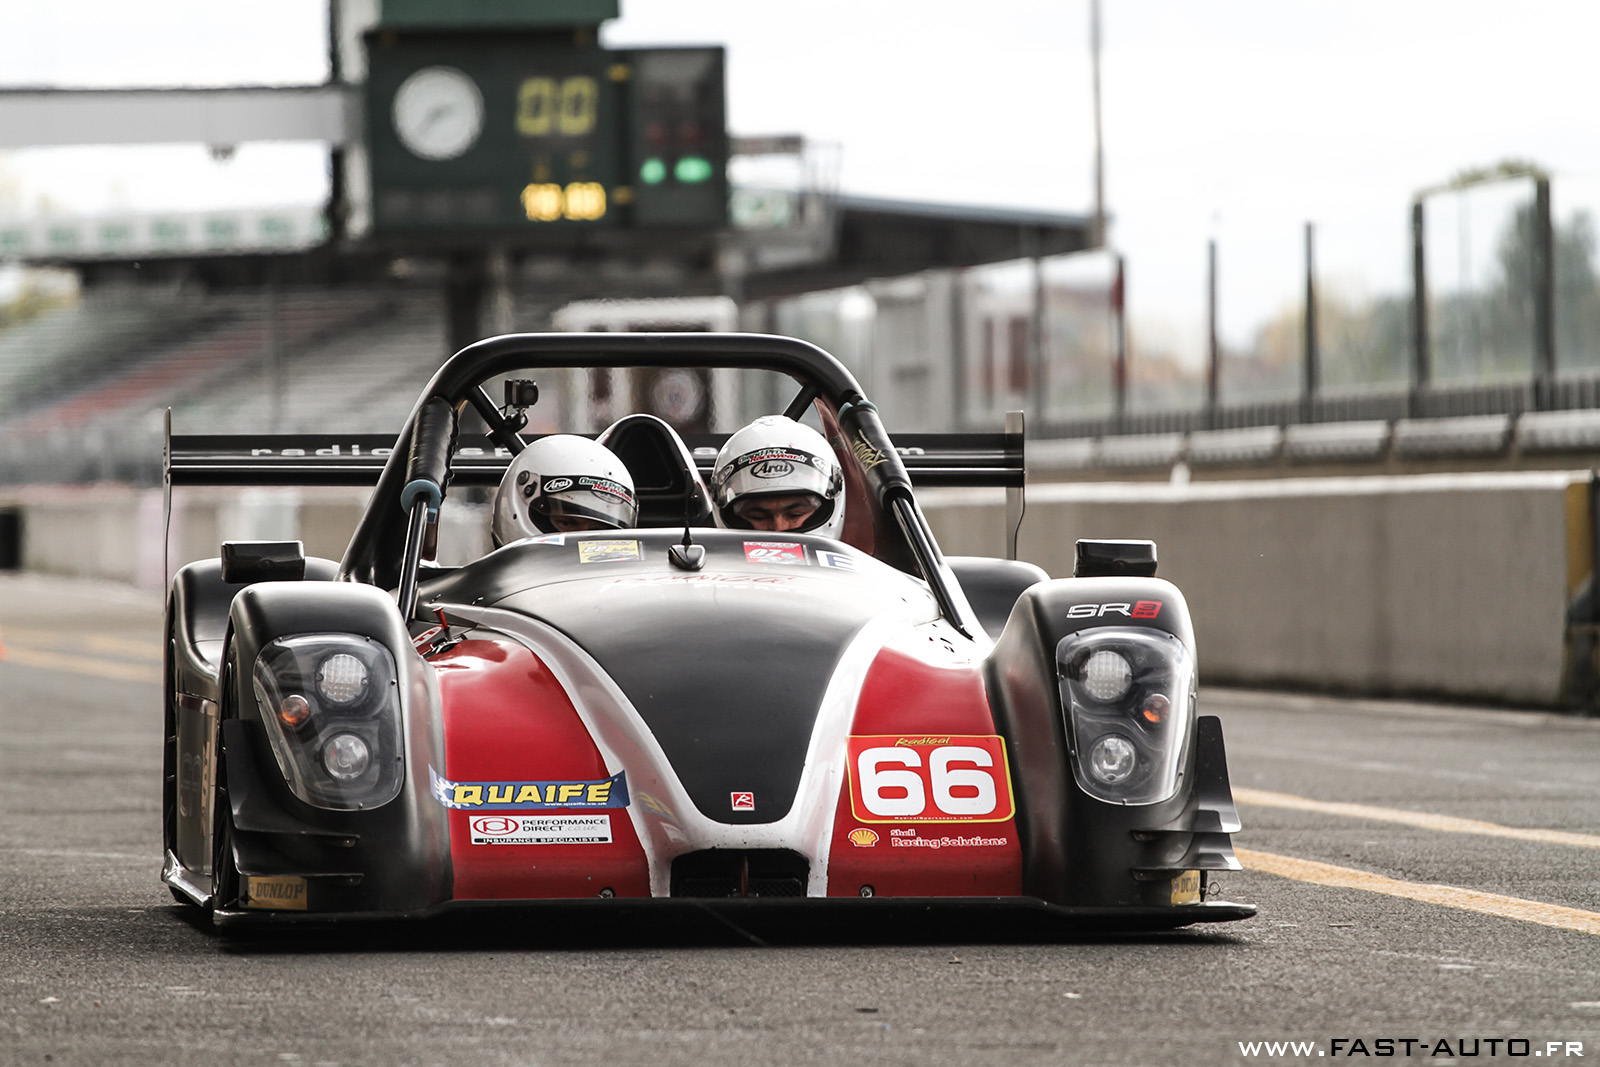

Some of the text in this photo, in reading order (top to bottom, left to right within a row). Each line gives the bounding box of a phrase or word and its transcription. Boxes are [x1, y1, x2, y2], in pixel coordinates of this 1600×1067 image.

[757, 461, 789, 474] Arai
[548, 479, 569, 491] Arai
[894, 735, 952, 747] Radical
[857, 746, 997, 816] 66
[453, 781, 613, 805] QUAIFE
[255, 882, 304, 899] DUNLOP
